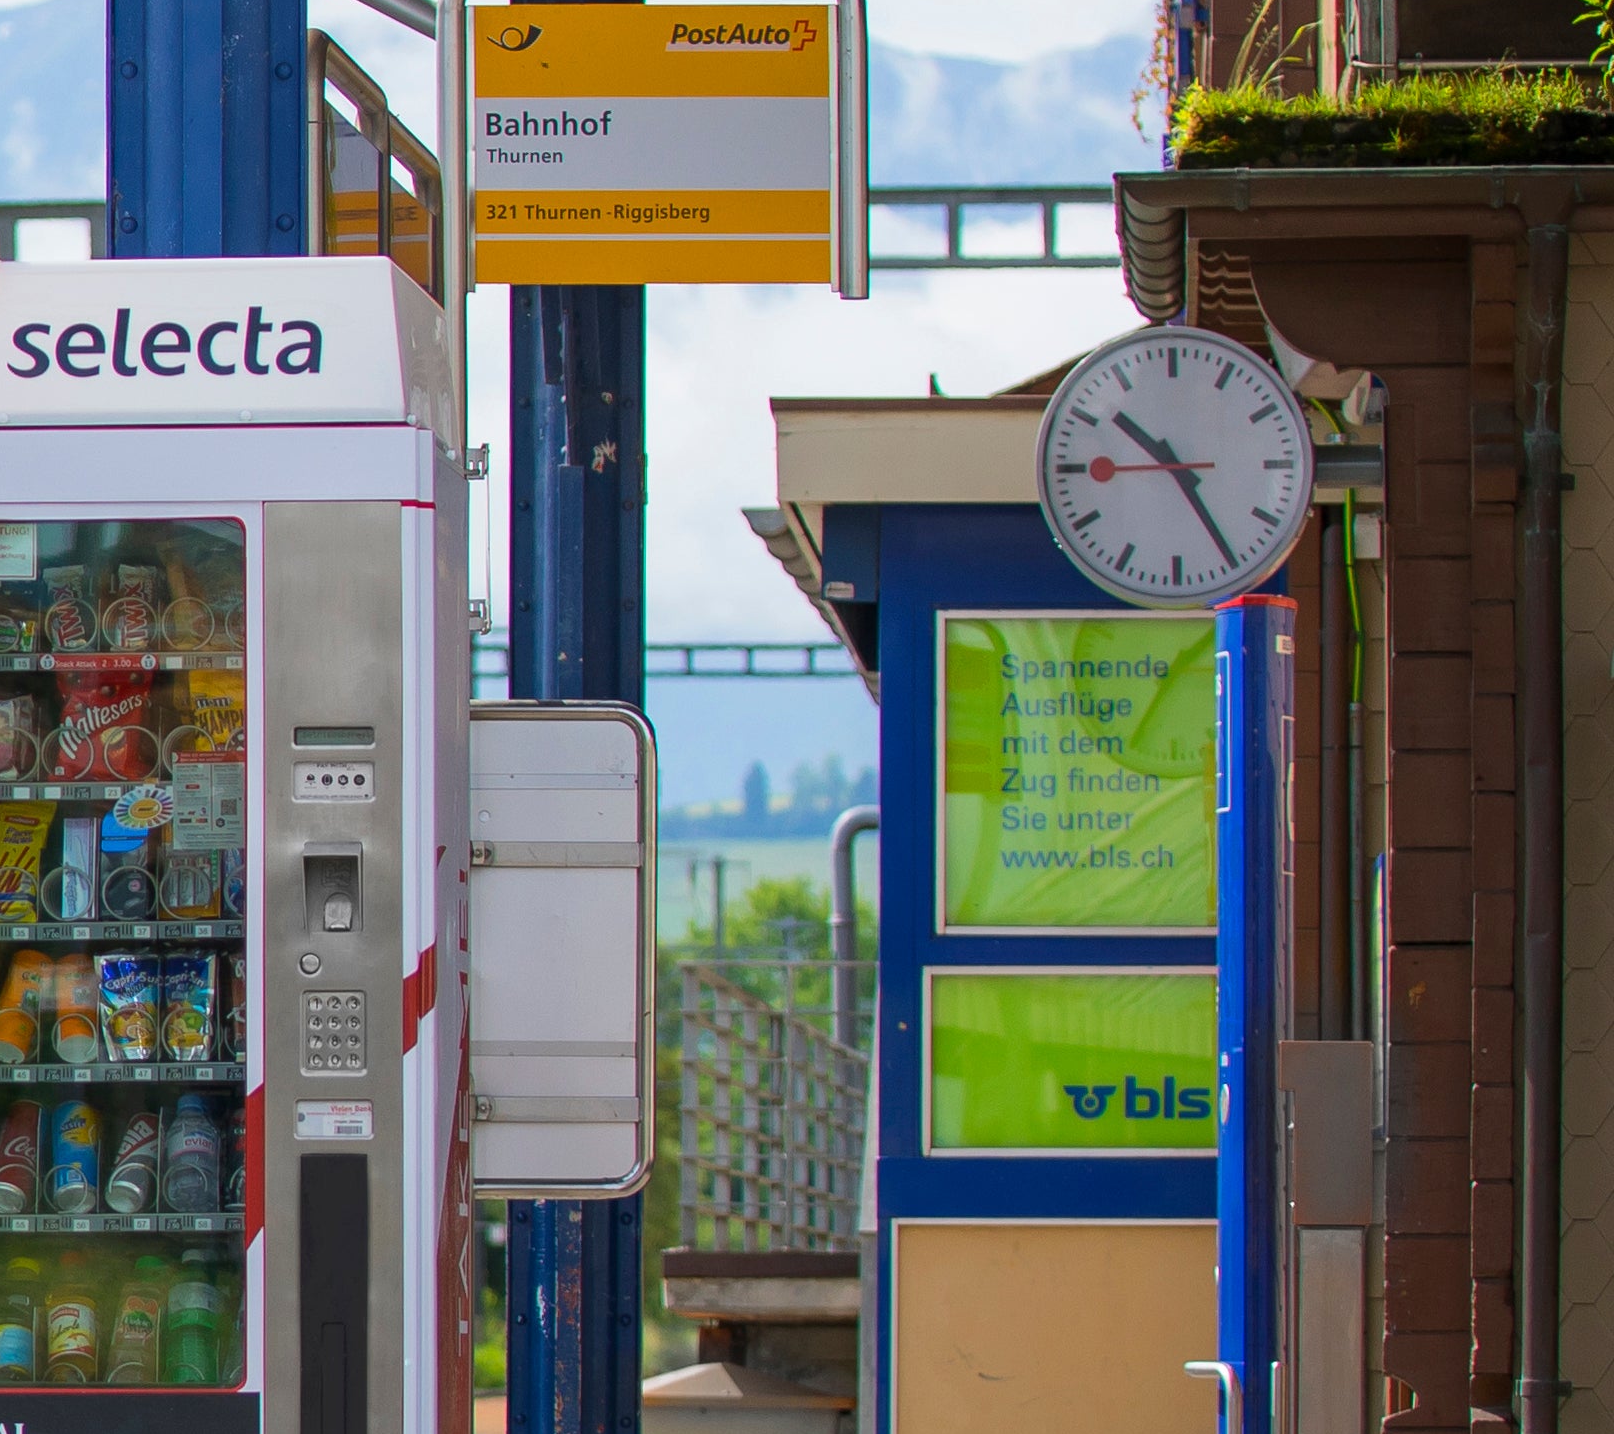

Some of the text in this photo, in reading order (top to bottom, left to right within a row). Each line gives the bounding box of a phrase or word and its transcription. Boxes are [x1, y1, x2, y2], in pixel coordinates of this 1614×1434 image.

[670, 23, 790, 45] PostAuto
[485, 110, 612, 137] Bahnhof
[486, 147, 563, 164] Thurnen
[486, 204, 517, 220] 321
[524, 204, 601, 220] Thurnen
[7, 306, 323, 378] selecta
[1000, 653, 1170, 686] Spannende
[1000, 691, 1133, 724] Ausflüge
[58, 694, 143, 760] Maltesers
[1001, 729, 1126, 756] mit dem
[1000, 766, 1161, 798] Zug finden
[1000, 804, 1135, 832] Sie unter
[1000, 843, 1176, 871] www.bls.ch
[312, 997, 358, 1009] 1 2 3
[312, 1017, 358, 1028] 4 5 6
[312, 1036, 358, 1047] 7 8 9
[1124, 1075, 1212, 1120] bls
[457, 1090, 469, 1357] TAKE
